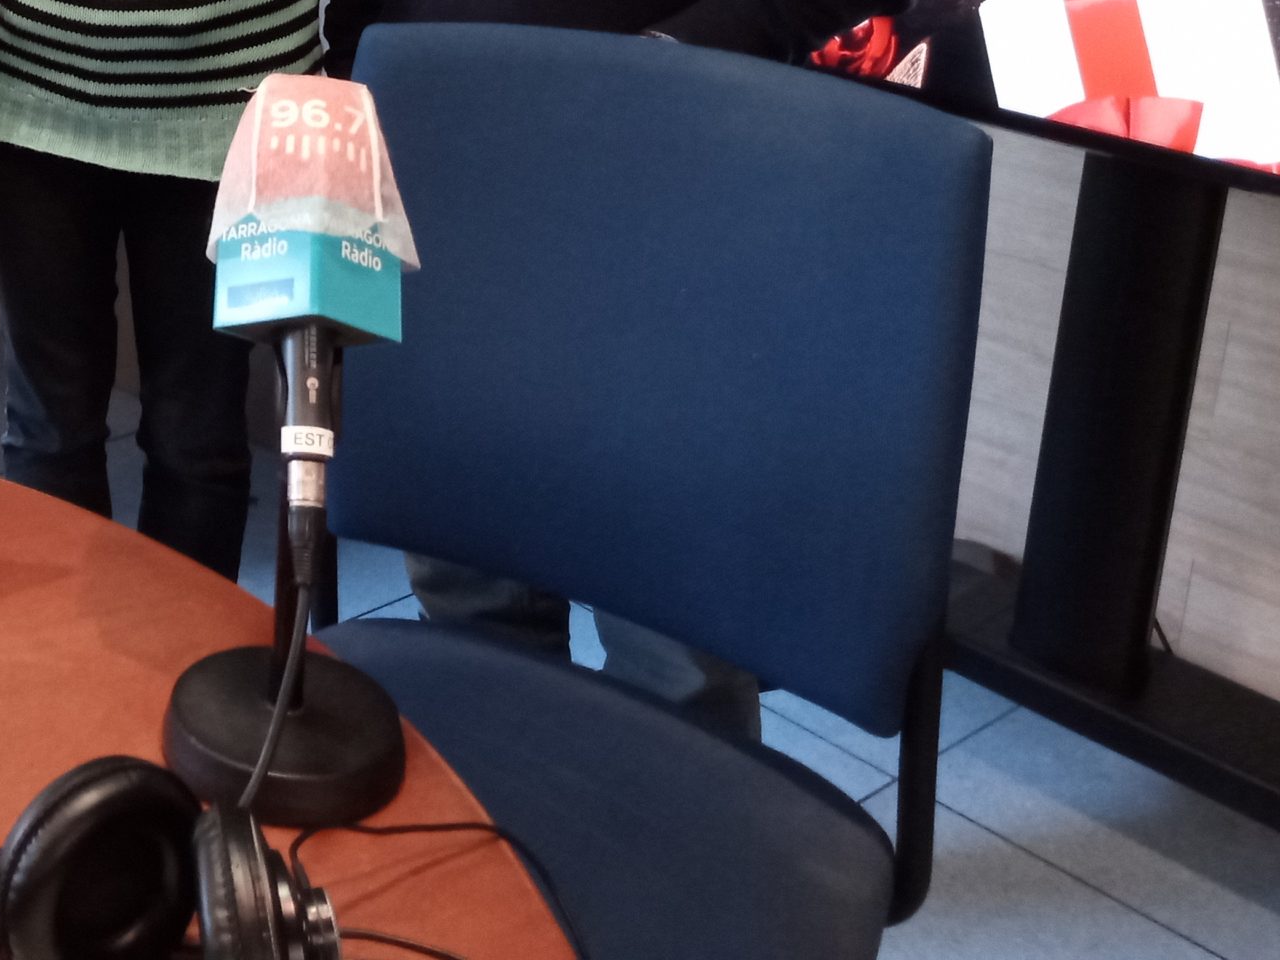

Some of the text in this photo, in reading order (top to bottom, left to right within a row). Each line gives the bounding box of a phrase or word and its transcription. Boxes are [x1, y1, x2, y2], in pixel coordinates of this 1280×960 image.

[270, 99, 366, 135] 96.7
[240, 237, 288, 262] Ràdio
[341, 241, 382, 272] Ràdio
[293, 432, 325, 447] EST
